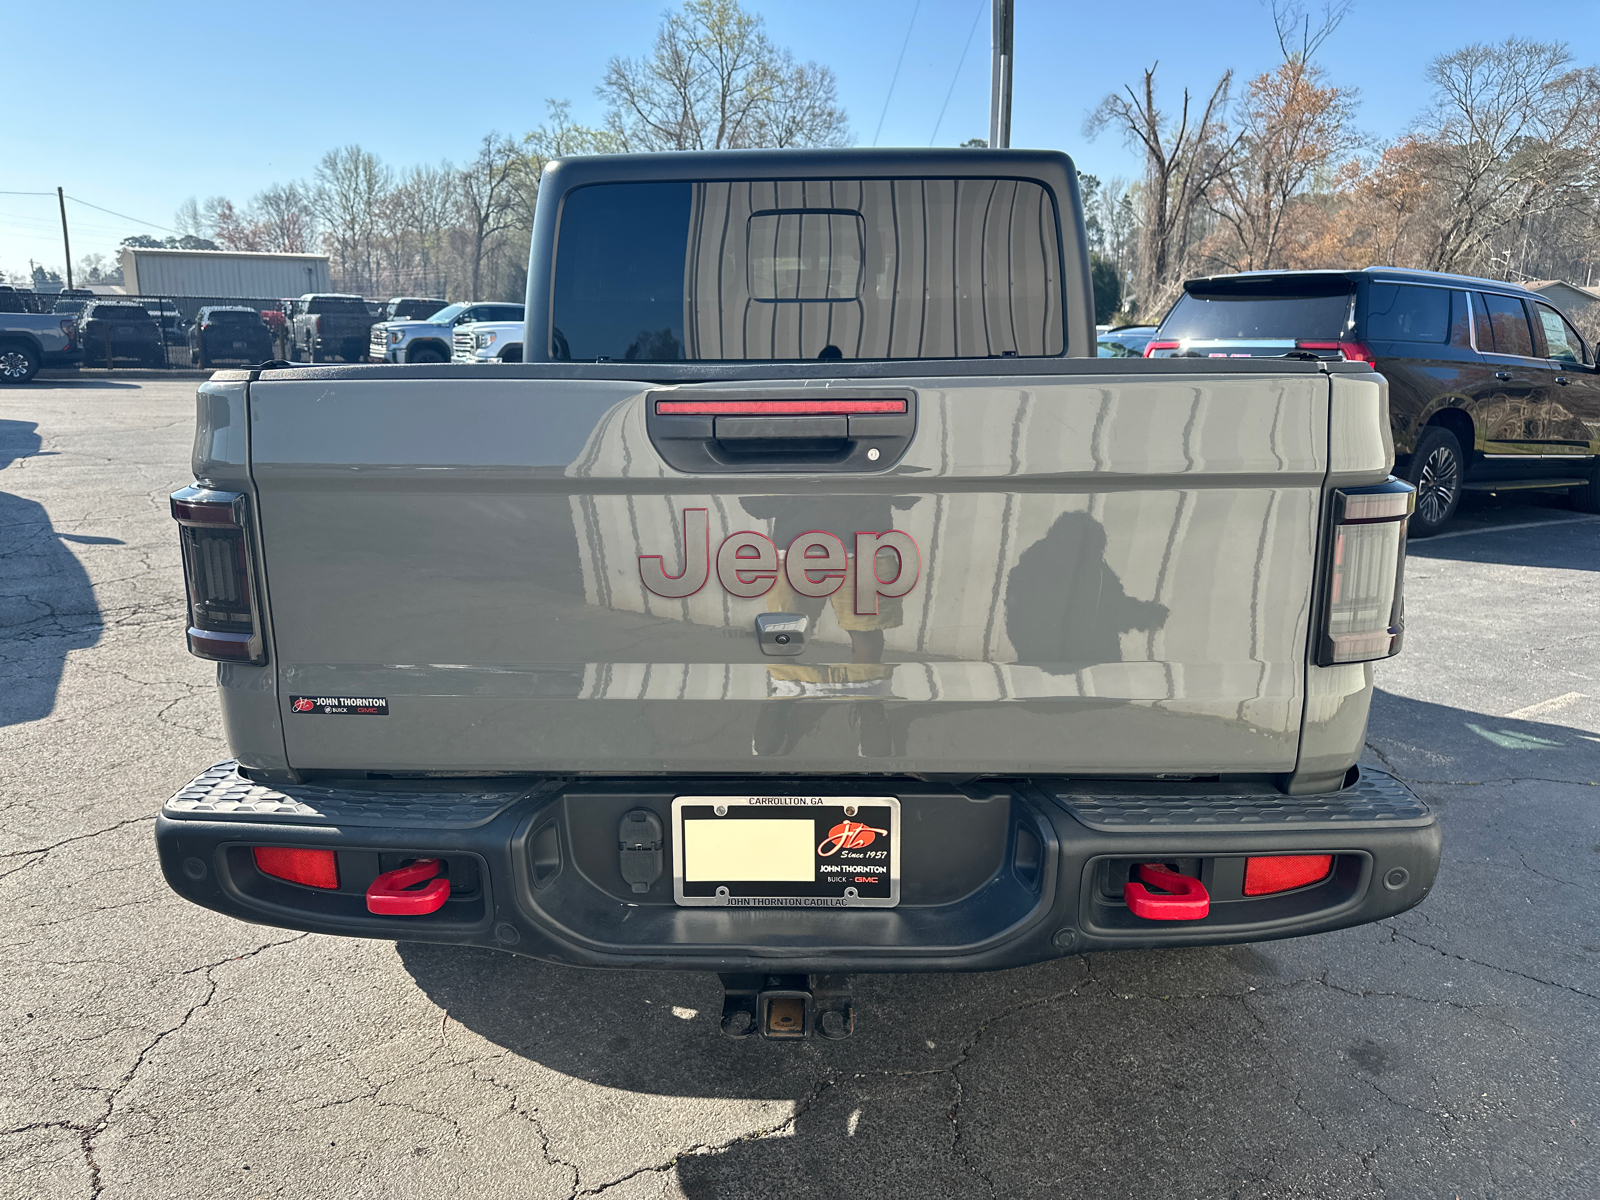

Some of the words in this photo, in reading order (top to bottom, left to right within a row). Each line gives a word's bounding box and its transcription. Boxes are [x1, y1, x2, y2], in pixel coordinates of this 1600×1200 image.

[639, 508, 921, 616] Jeep
[316, 698, 338, 706] JOHN
[340, 698, 386, 707] THORNTON
[810, 797, 824, 805] GA
[840, 850, 864, 859] Since
[865, 851, 888, 859] 1957
[819, 865, 840, 873] JOHN
[841, 865, 887, 873] THORNTON
[726, 898, 749, 907] JOHN
[751, 898, 801, 907] THORNTON
[803, 898, 848, 907] CADILLAC
